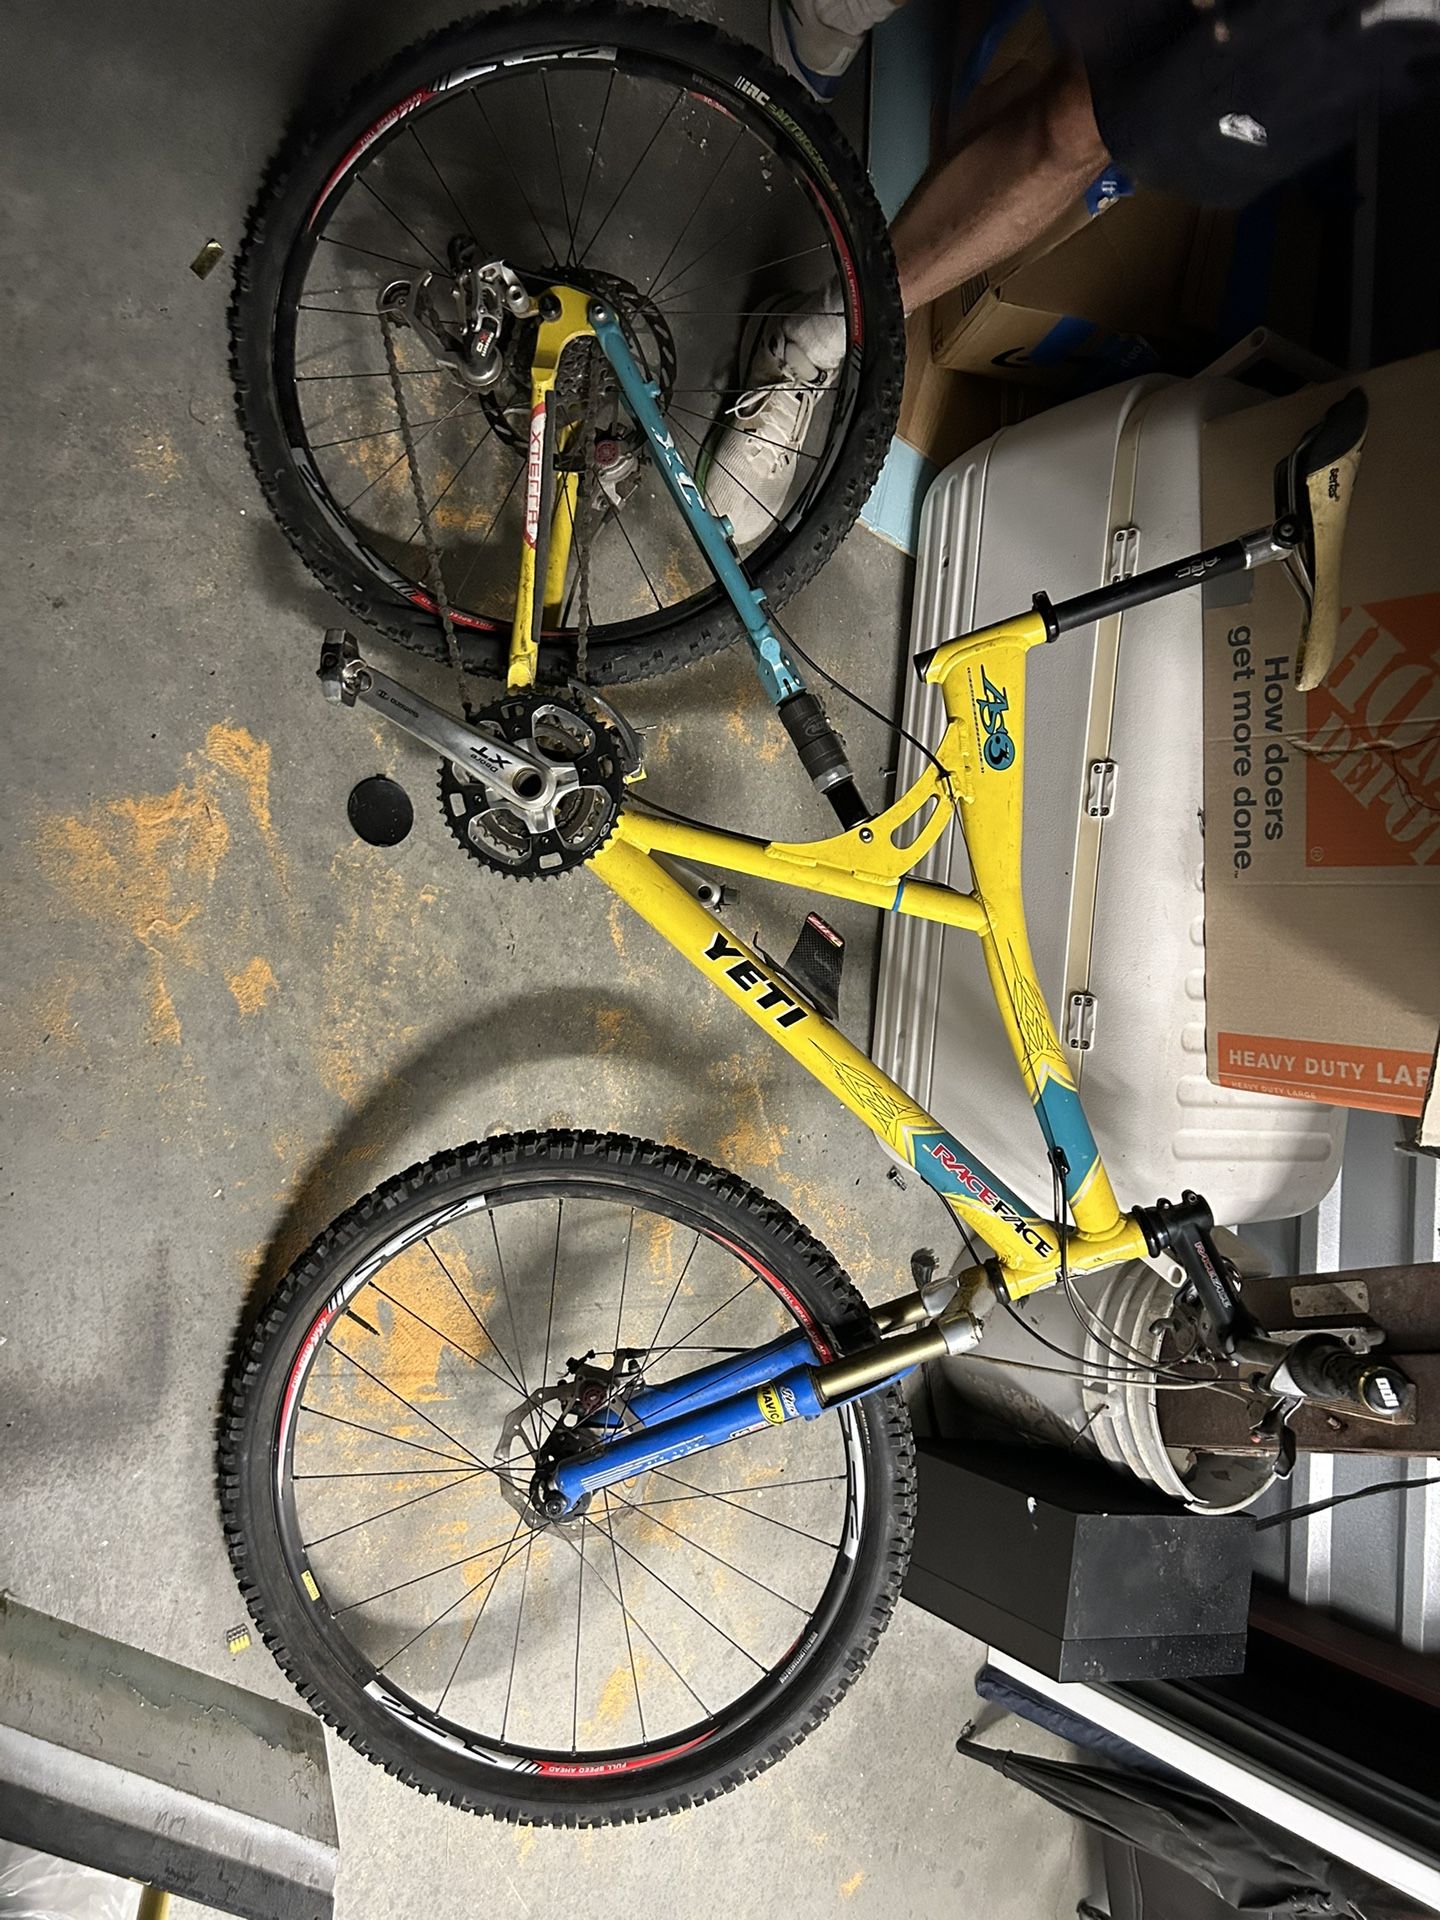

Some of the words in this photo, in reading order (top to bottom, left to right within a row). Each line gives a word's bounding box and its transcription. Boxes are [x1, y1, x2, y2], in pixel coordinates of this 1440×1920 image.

[1228, 625, 1256, 681] get
[1264, 656, 1289, 733] How
[1232, 692, 1252, 777] more
[470, 746, 513, 770] XT
[470, 752, 499, 774] Deore
[1264, 744, 1289, 841] doers
[704, 931, 809, 1029] YETI
[1229, 1048, 1297, 1072] HEAVY
[1304, 1057, 1366, 1081] DUTY
[1231, 1080, 1260, 1092] HEAVY
[1261, 1084, 1285, 1096] DUTY
[1286, 1088, 1318, 1100] LARGE
[779, 1286, 796, 1306] FULL
[794, 1304, 812, 1329] SPEED
[809, 1328, 828, 1356] AHEAD
[758, 1383, 781, 1421] MAVIC
[548, 1764, 577, 1774] AHEAD
[577, 1764, 604, 1774] SPEED
[605, 1761, 628, 1771] FULL
